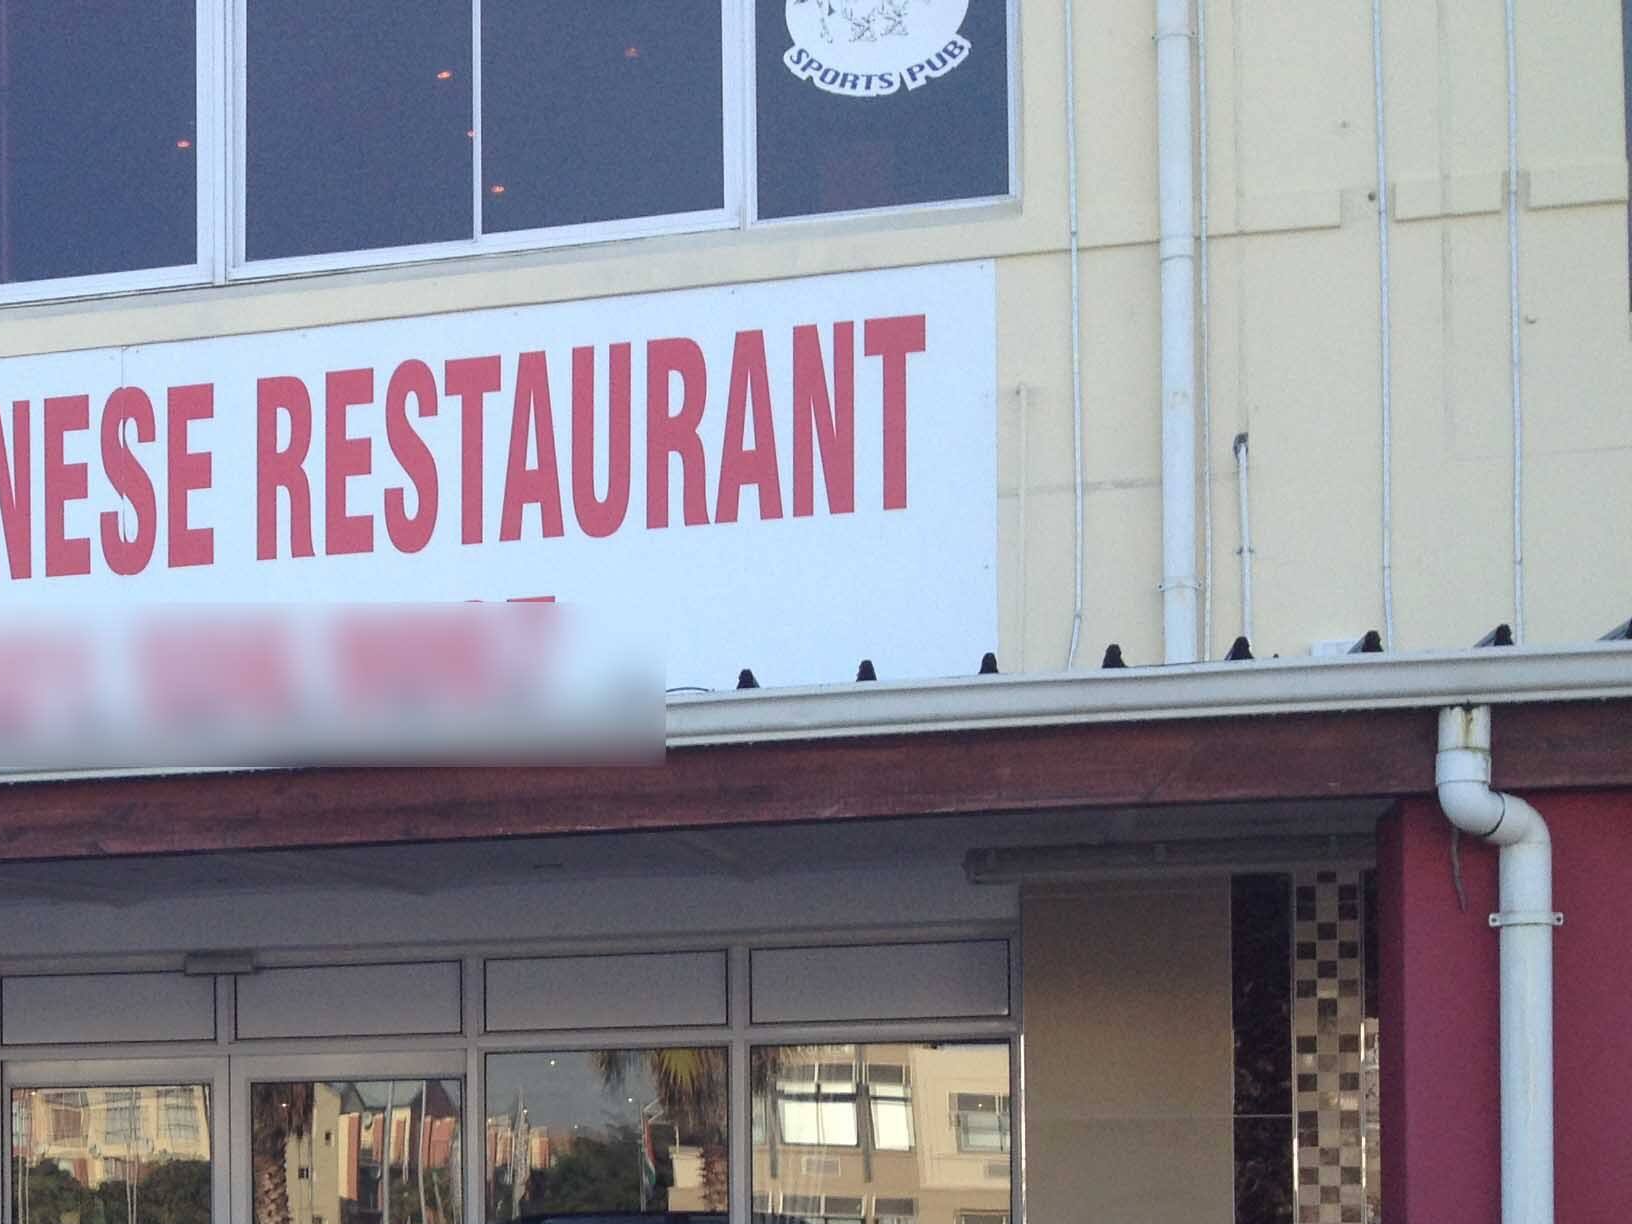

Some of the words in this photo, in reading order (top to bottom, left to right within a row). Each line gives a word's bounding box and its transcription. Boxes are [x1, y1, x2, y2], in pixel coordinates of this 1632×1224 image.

[789, 47, 895, 91] SPORTS
[905, 39, 965, 84] PUB
[256, 314, 927, 561] RESTAURANT
